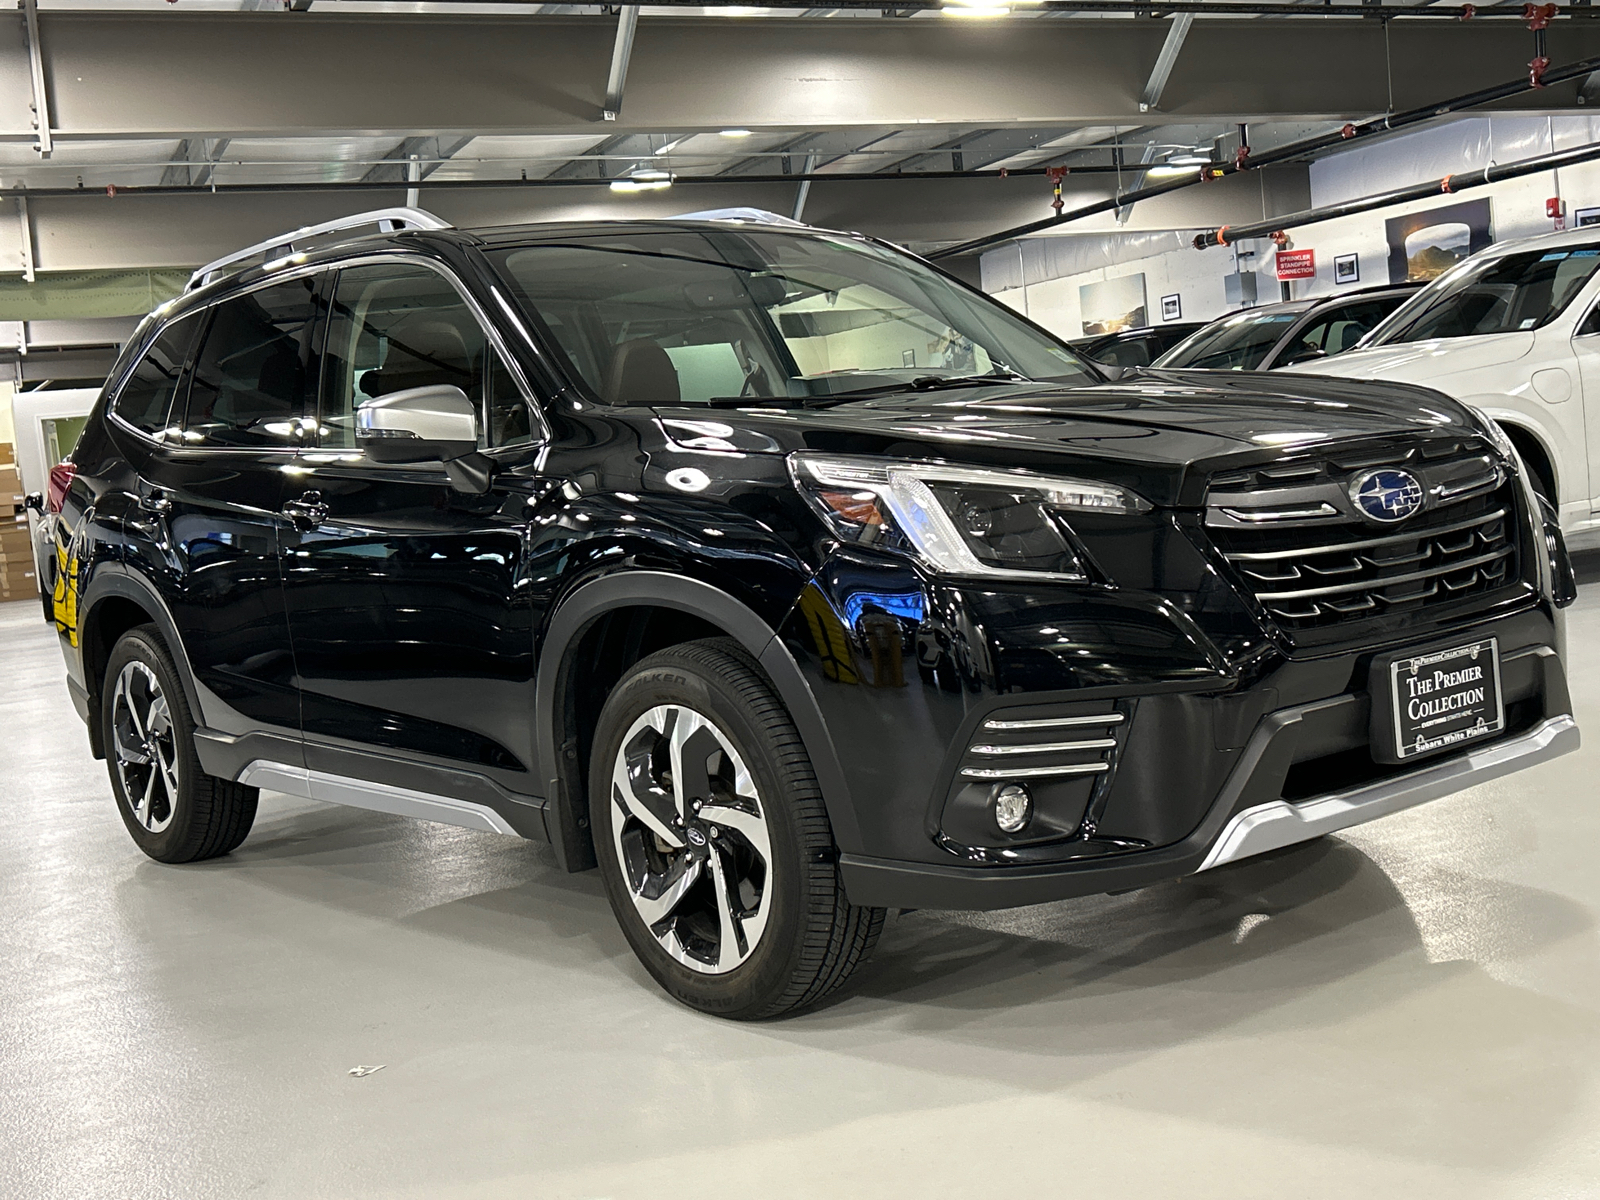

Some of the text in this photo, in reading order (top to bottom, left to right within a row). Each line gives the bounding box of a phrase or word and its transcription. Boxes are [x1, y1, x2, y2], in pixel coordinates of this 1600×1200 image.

[1279, 254, 1311, 262] SPRINKLER
[1280, 260, 1311, 269] STANDPIPE
[1277, 267, 1313, 276] CONNECTION
[1406, 666, 1483, 698] THE PREMIER
[1407, 687, 1484, 720] COLLECTION
[1415, 726, 1489, 752] Subaru White Plains
